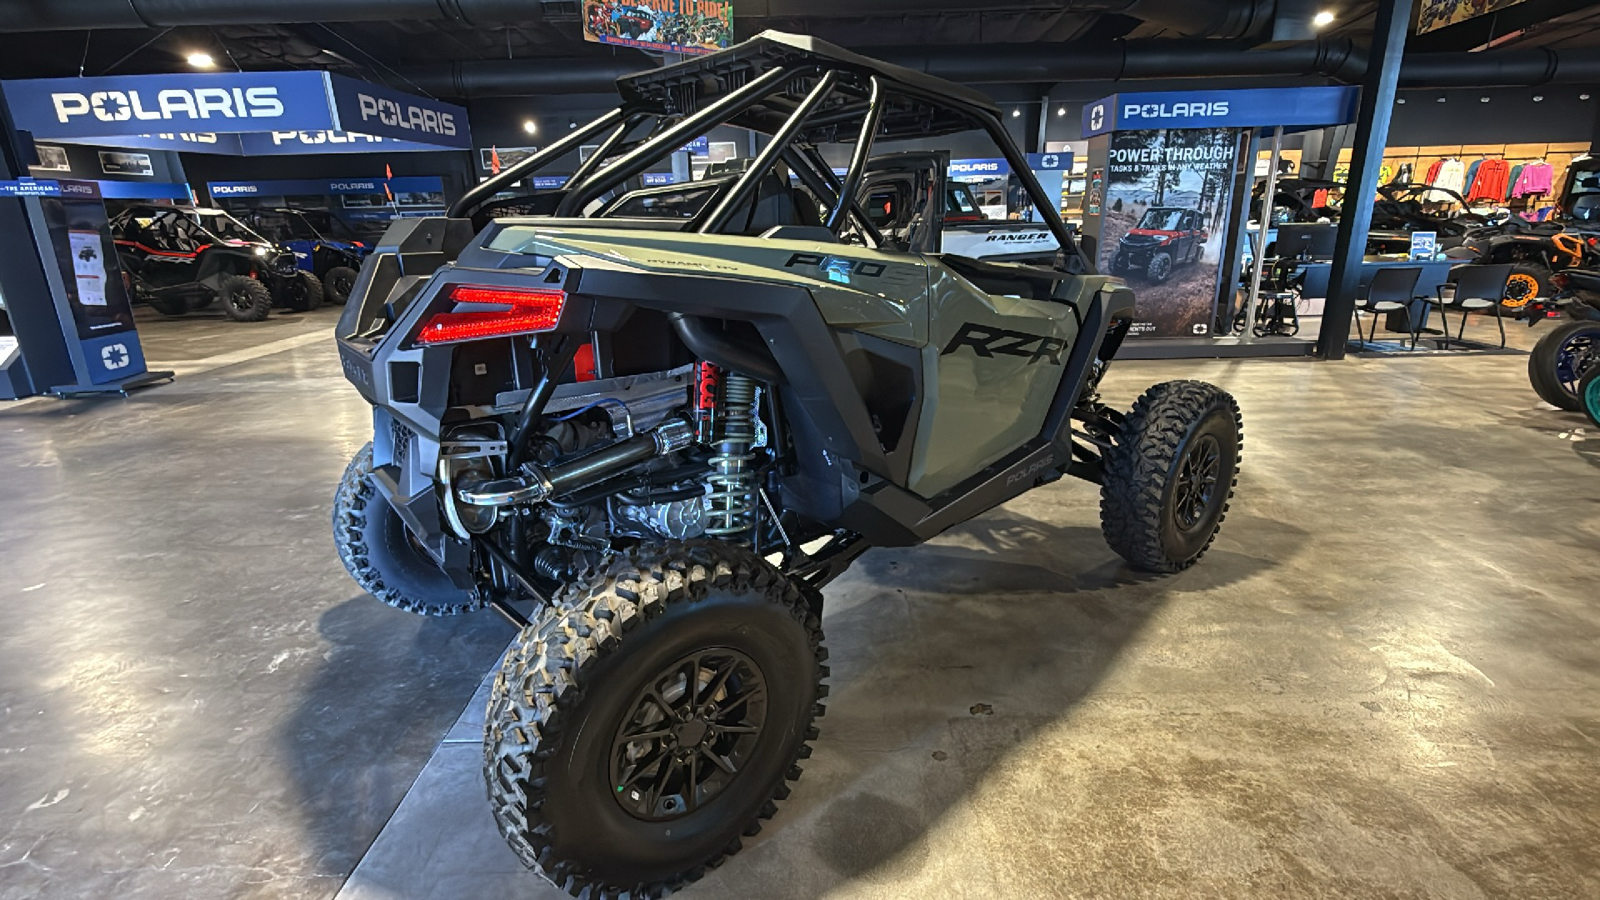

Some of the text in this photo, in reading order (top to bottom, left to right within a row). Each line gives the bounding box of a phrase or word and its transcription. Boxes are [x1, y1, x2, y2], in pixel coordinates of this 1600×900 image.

[696, 0, 729, 28] RIDE!
[51, 87, 284, 123] POLARIS
[1123, 101, 1230, 119] POLARIS
[357, 92, 457, 136] POLARIS
[1109, 146, 1234, 163] POWER THROUGH
[951, 162, 999, 173] POLARIS
[1110, 165, 1133, 173] TASKS
[1141, 164, 1167, 172] TRAILS
[1176, 163, 1192, 171] ANY
[1193, 162, 1228, 170] WEATHER
[212, 185, 258, 194] POLARIS
[330, 182, 375, 190] POLARIS
[985, 232, 1049, 242] RANGER
[939, 321, 1069, 366] RZR
[1006, 453, 1054, 488] POLARIS
